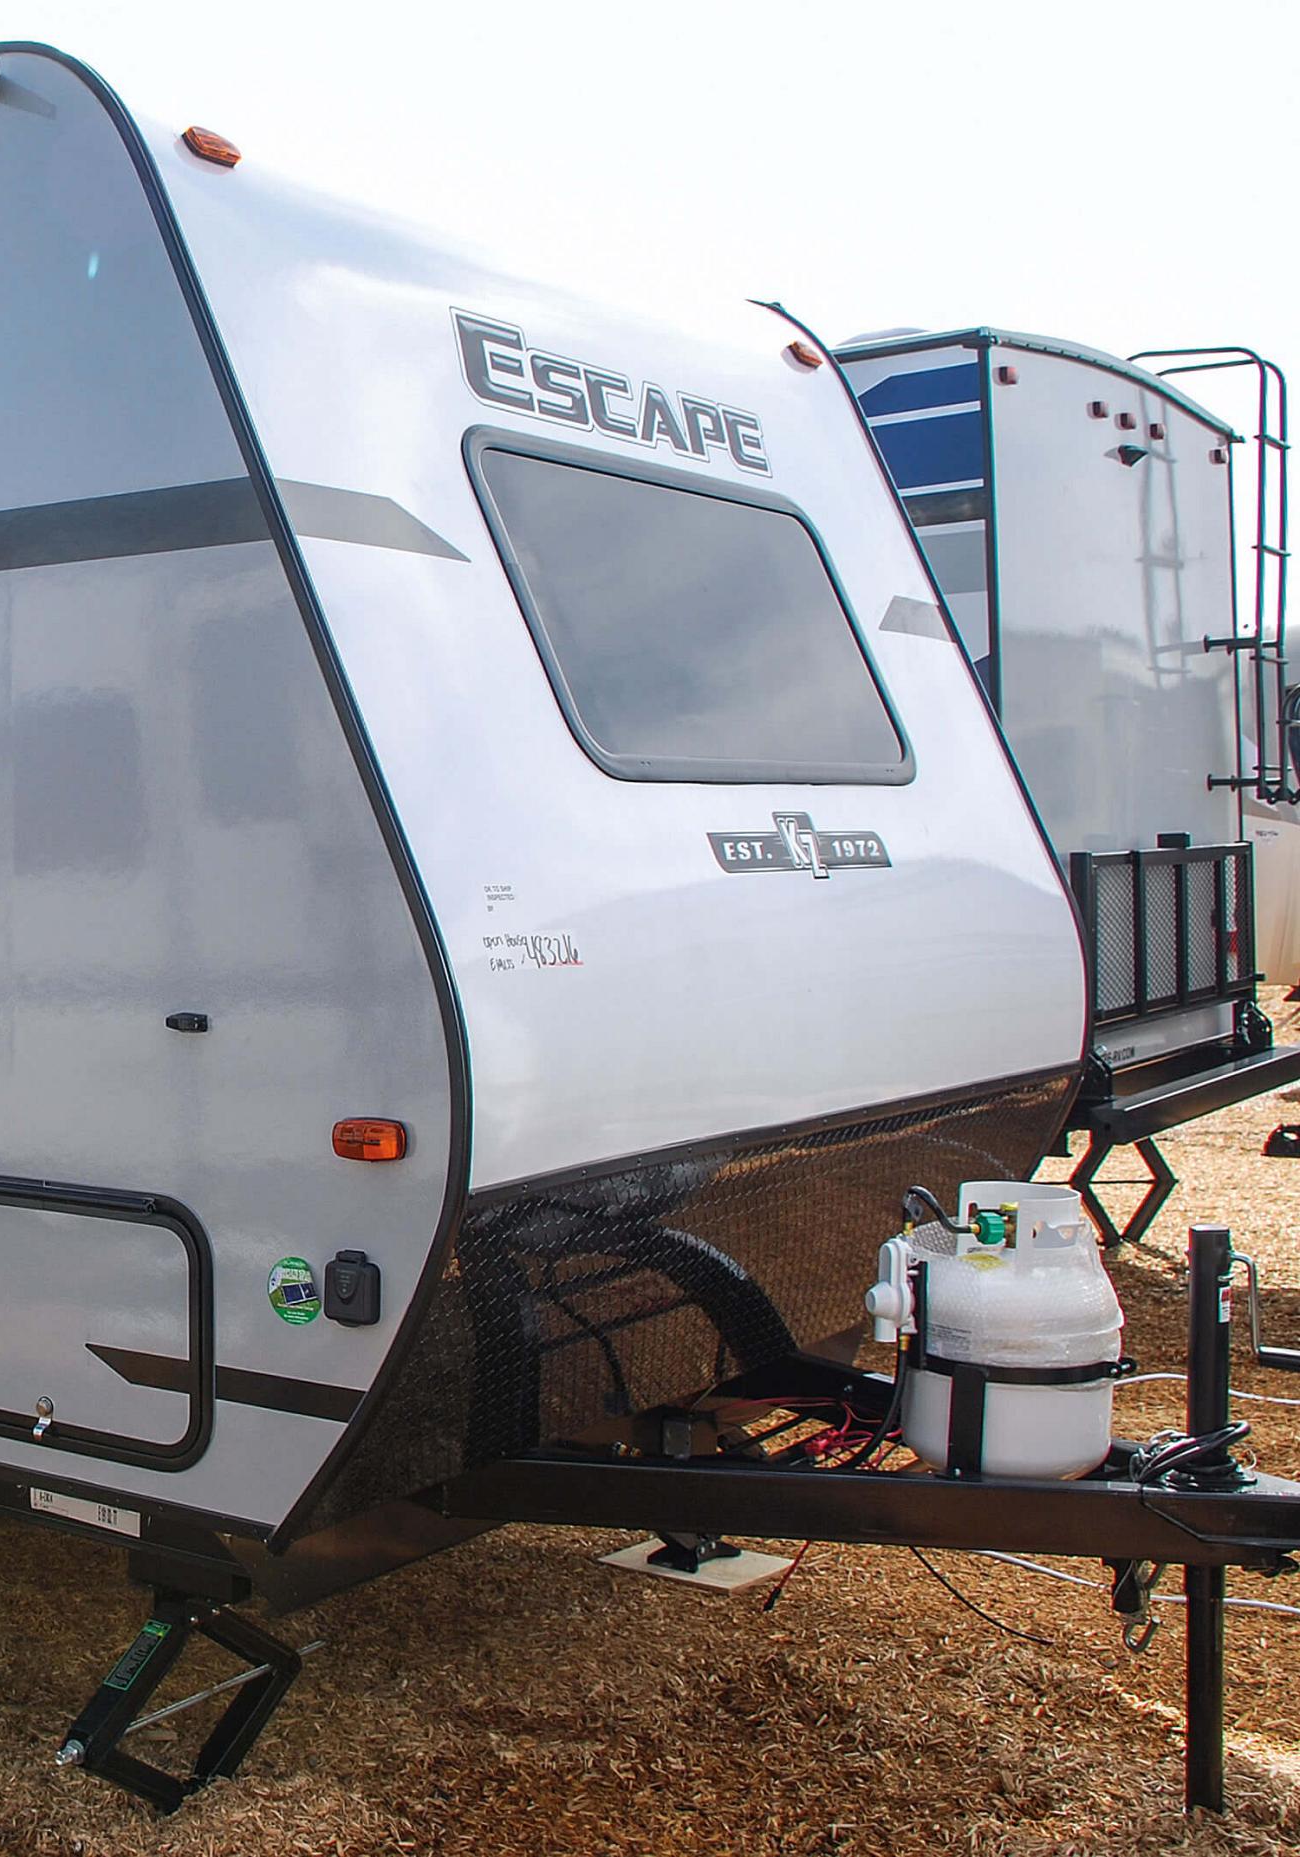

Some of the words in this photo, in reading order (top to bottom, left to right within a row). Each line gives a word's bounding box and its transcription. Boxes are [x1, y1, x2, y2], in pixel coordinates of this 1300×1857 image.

[450, 306, 773, 478] ESCAPE
[723, 841, 773, 861] EST.
[831, 840, 881, 859] 1972
